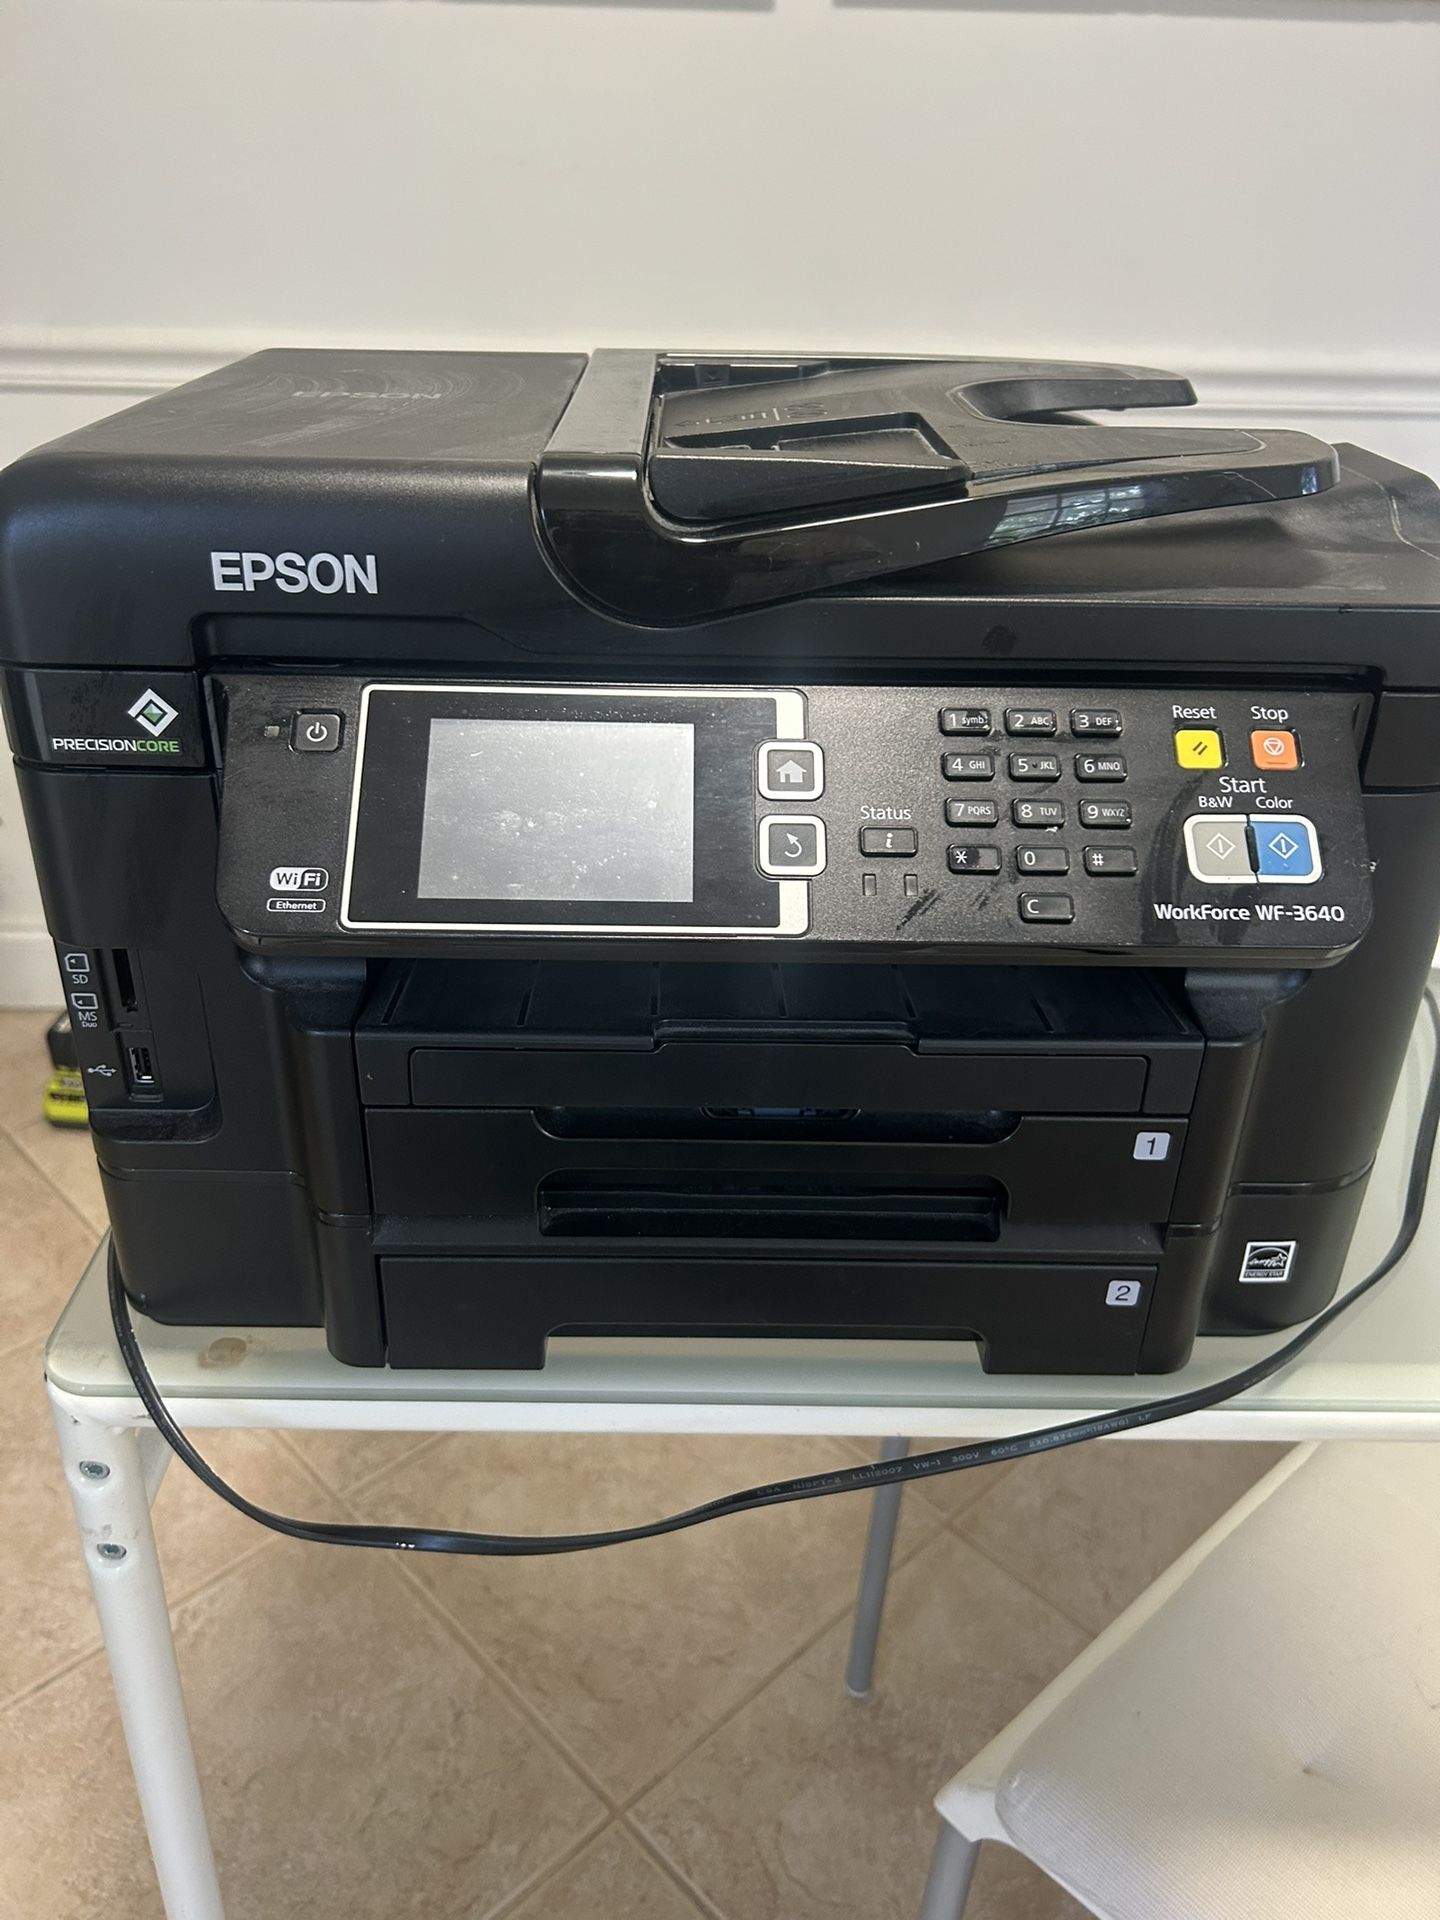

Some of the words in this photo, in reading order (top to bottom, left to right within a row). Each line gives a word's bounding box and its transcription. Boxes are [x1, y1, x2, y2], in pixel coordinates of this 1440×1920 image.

[210, 551, 379, 595] EPSON
[1172, 705, 1217, 719] Reset
[1250, 706, 1289, 723] Stop
[949, 713, 958, 727] 1
[1014, 714, 1025, 728] 2
[1030, 716, 1050, 726] ABC
[1078, 714, 1090, 729] 3
[1095, 717, 1112, 727] DEF
[52, 737, 181, 753] PRECISIONCORE
[952, 758, 963, 772] 4
[968, 760, 986, 770] GHI
[1017, 758, 1029, 772] 5
[1039, 760, 1055, 770] JKL
[1083, 759, 1095, 774] 6
[1097, 761, 1121, 771] MNO
[1218, 776, 1267, 793] Start
[1198, 796, 1233, 808] B&W
[1255, 797, 1293, 809] Color
[860, 805, 912, 820] Status
[955, 803, 965, 817] 7
[967, 805, 992, 816] PQRS
[1021, 804, 1033, 818] 8
[1039, 807, 1058, 817] TUV
[1087, 805, 1099, 819] 9
[1101, 808, 1125, 818] WXYZ
[1024, 850, 1036, 866] 0
[1091, 852, 1104, 867] #
[275, 900, 318, 911] Ethernet
[1027, 899, 1040, 914] C
[1153, 903, 1251, 921] WorkForce
[1254, 904, 1346, 923] WF-3640
[72, 974, 89, 984] SD
[78, 1011, 98, 1022] MS
[1147, 1137, 1156, 1155] 1
[1115, 1285, 1131, 1301] 2
[912, 1459, 941, 1471] VW-1
[951, 1451, 980, 1463] 300V
